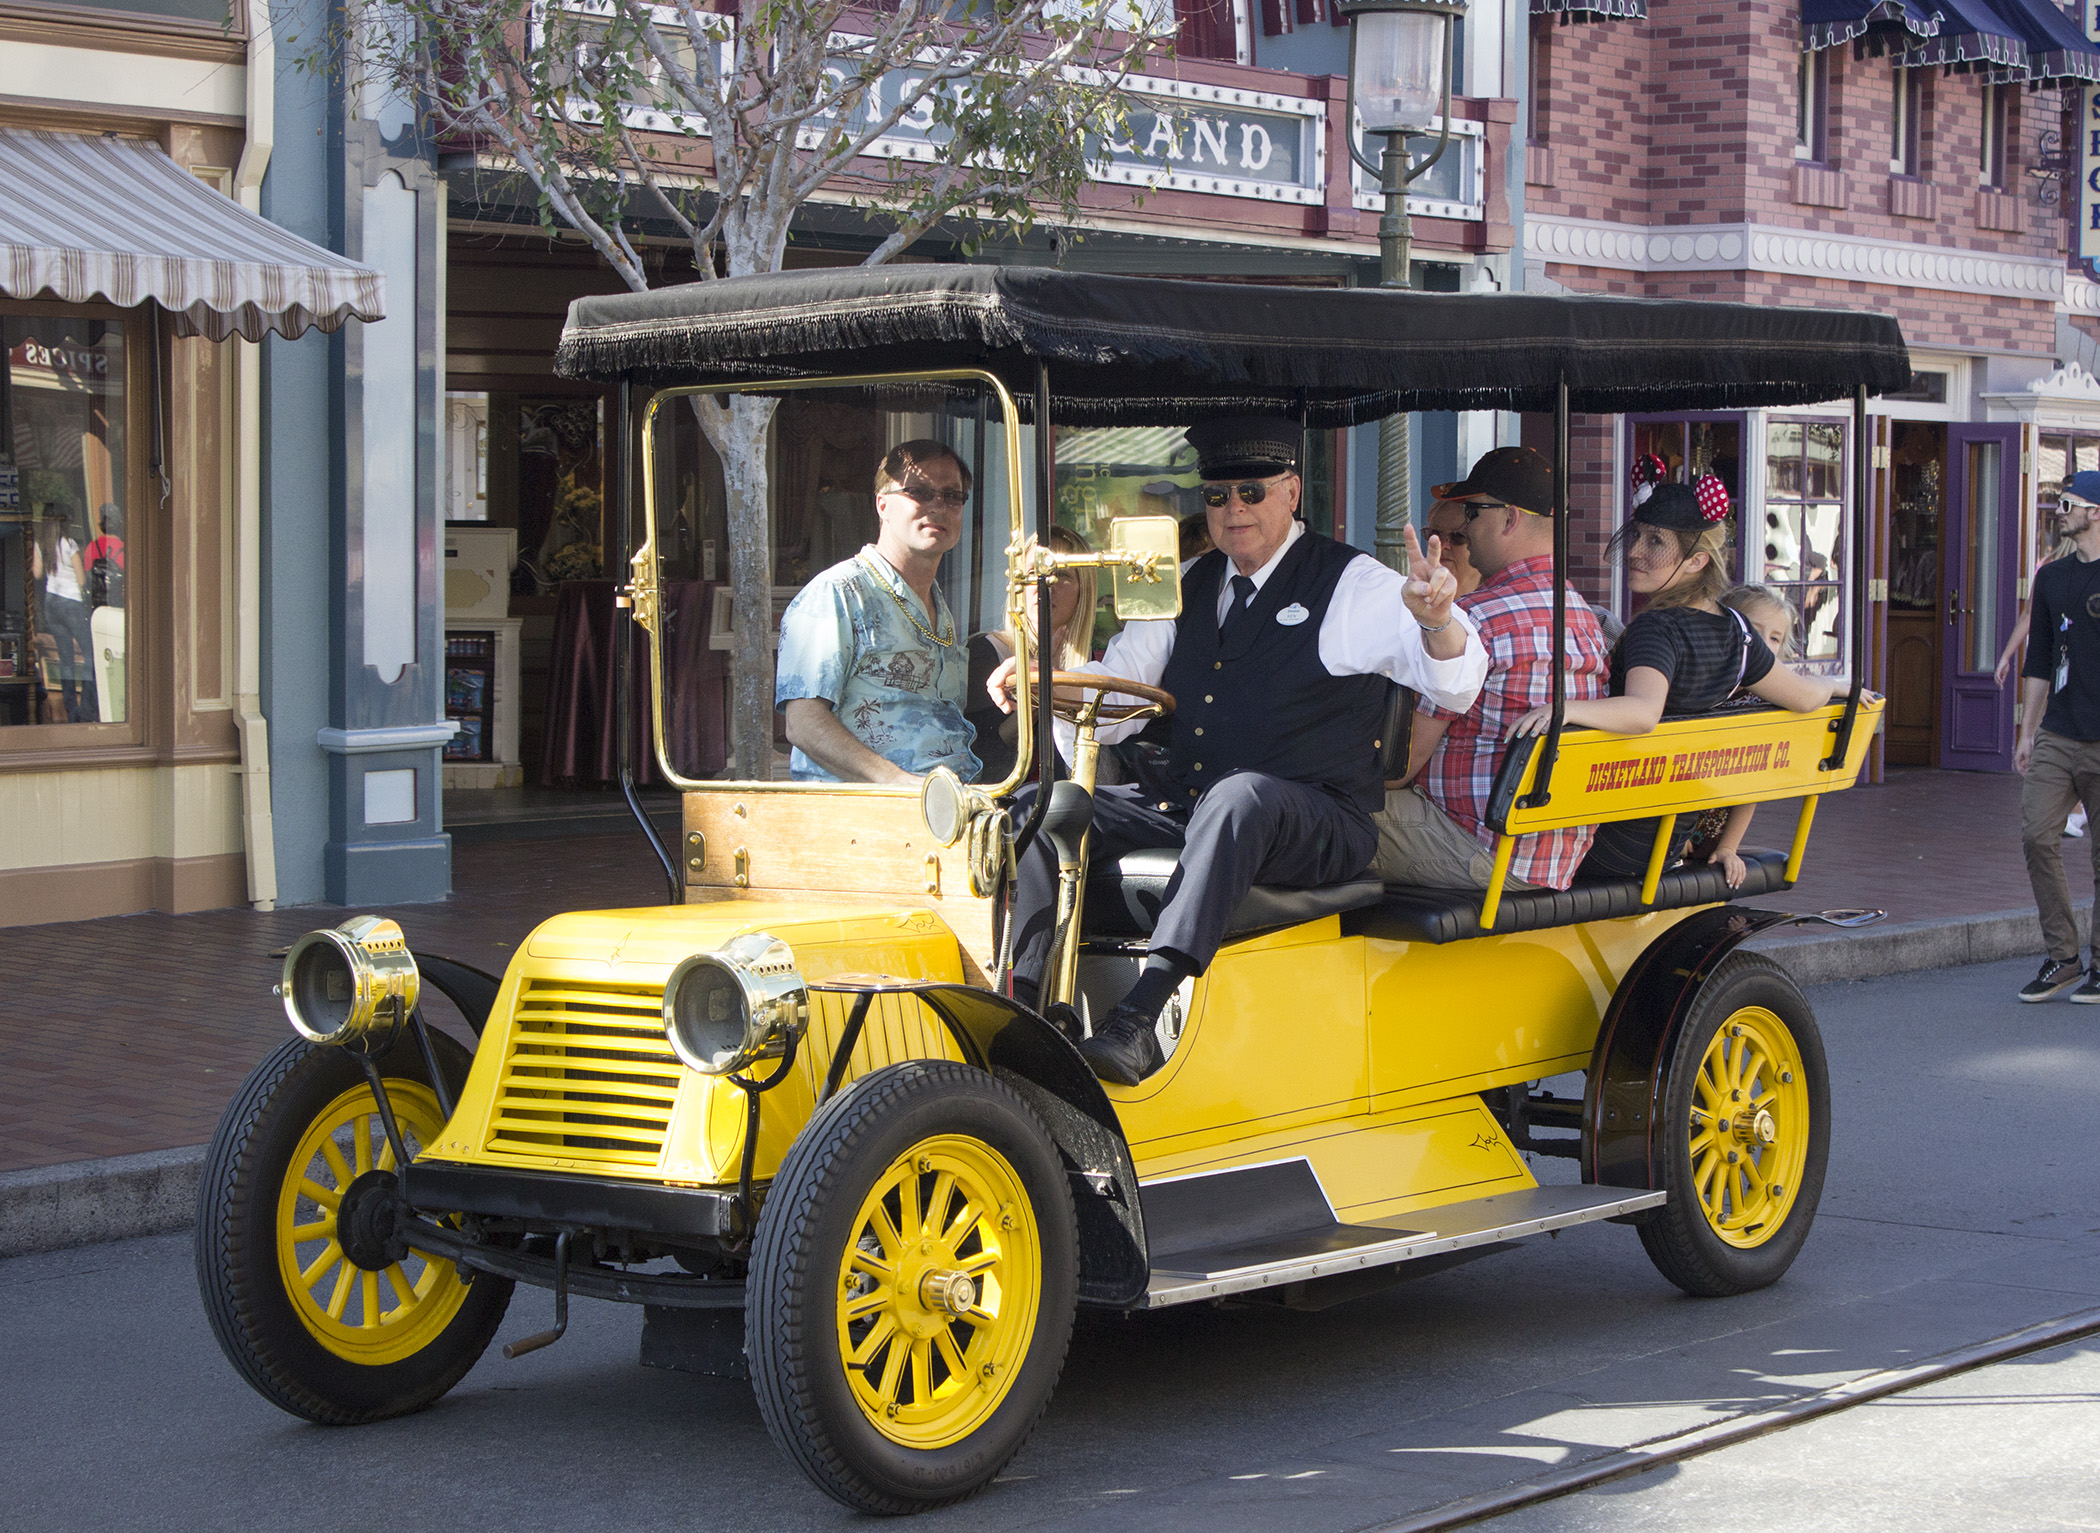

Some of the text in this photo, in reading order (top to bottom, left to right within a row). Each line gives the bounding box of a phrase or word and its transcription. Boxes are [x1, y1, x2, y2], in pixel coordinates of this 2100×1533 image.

[1585, 741, 1790, 793] DISNEYLAND TRANSPORTATION CO.
